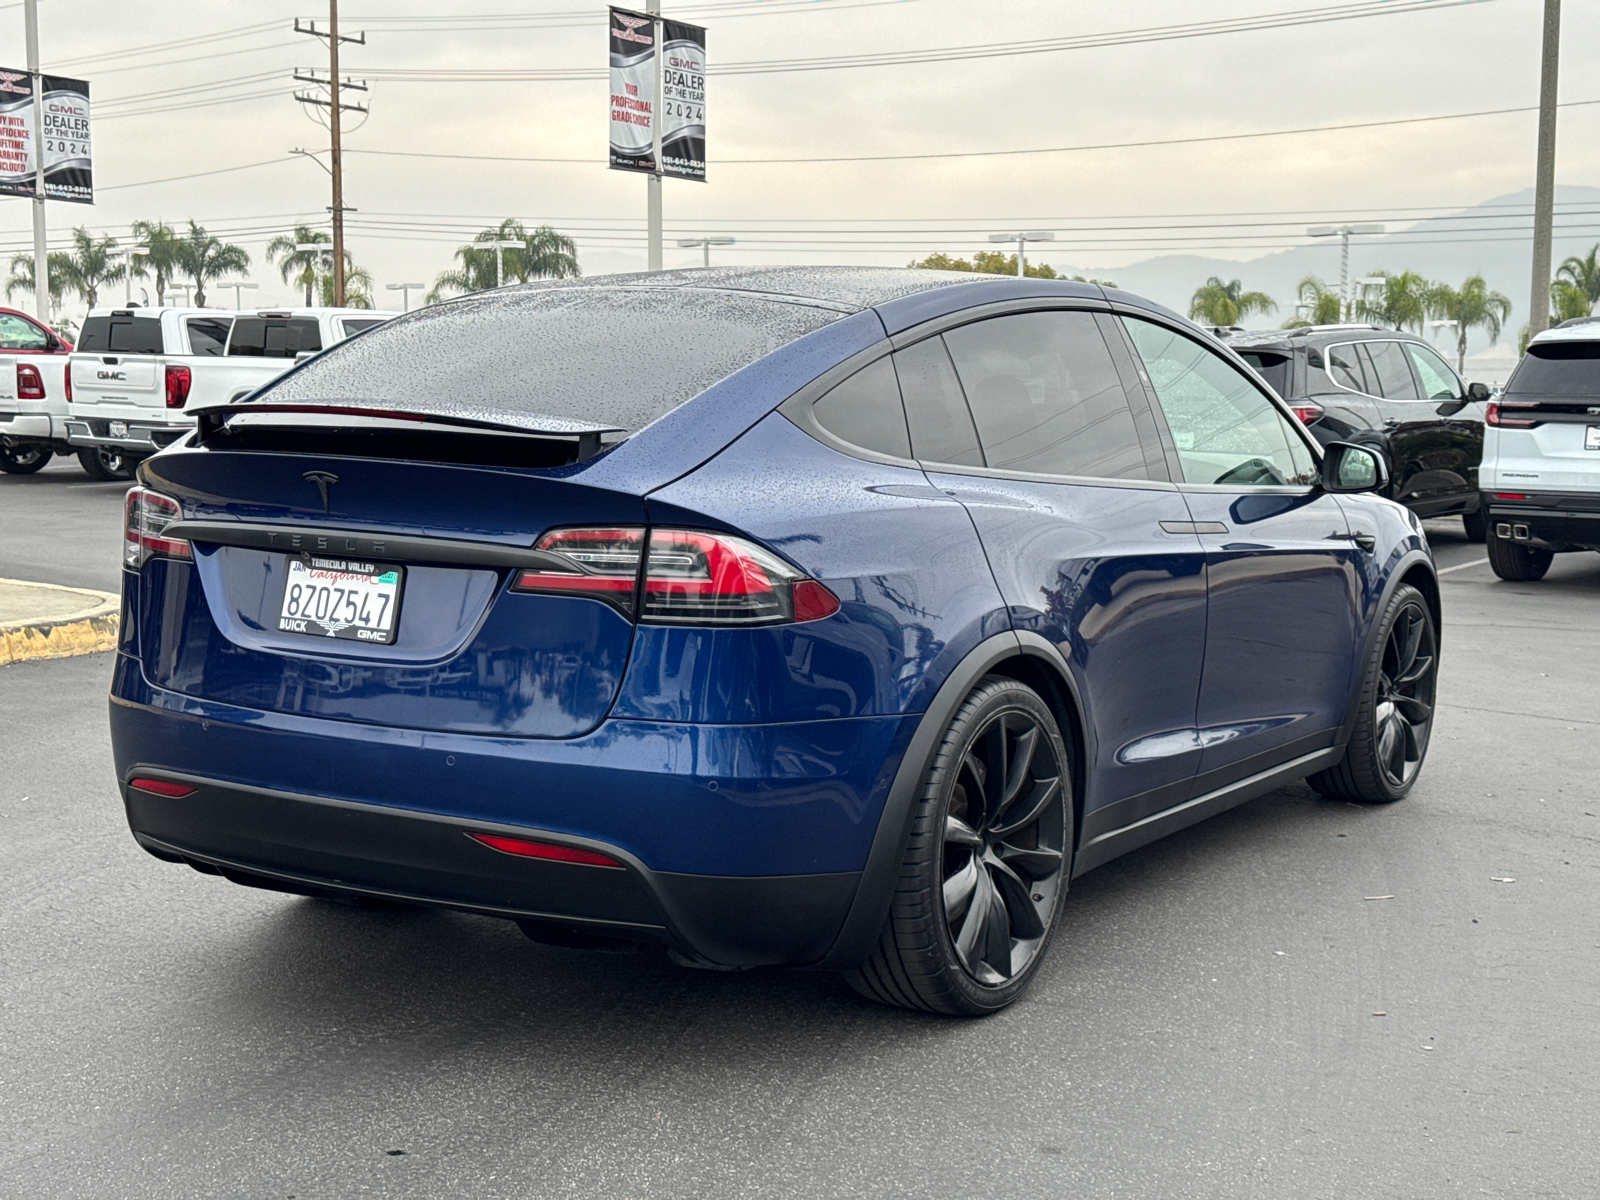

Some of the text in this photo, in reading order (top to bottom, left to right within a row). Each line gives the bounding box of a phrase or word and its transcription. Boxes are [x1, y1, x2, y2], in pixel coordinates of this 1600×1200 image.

[669, 57, 700, 71] GMC
[664, 69, 705, 92] DEALER
[664, 86, 705, 101] OF THE YEAR
[49, 104, 84, 116] GMC
[611, 109, 633, 124] GRADE
[666, 102, 703, 121] 2024
[8, 116, 25, 128] WITH
[44, 114, 89, 132] DEALER
[0, 126, 30, 140] NFIDENCE
[44, 127, 90, 140] OF THE YEAR
[0, 138, 25, 151] IFETIME
[46, 140, 88, 156] 2024
[0, 149, 29, 162] ARRANTY
[0, 161, 26, 173] NCLUDED
[97, 370, 127, 381] GMC
[268, 533, 385, 553] TESLA
[311, 557, 375, 573] TEMECULA VALLEY
[309, 568, 379, 586] California
[280, 618, 308, 632] BUICK
[357, 629, 387, 641] GMC
